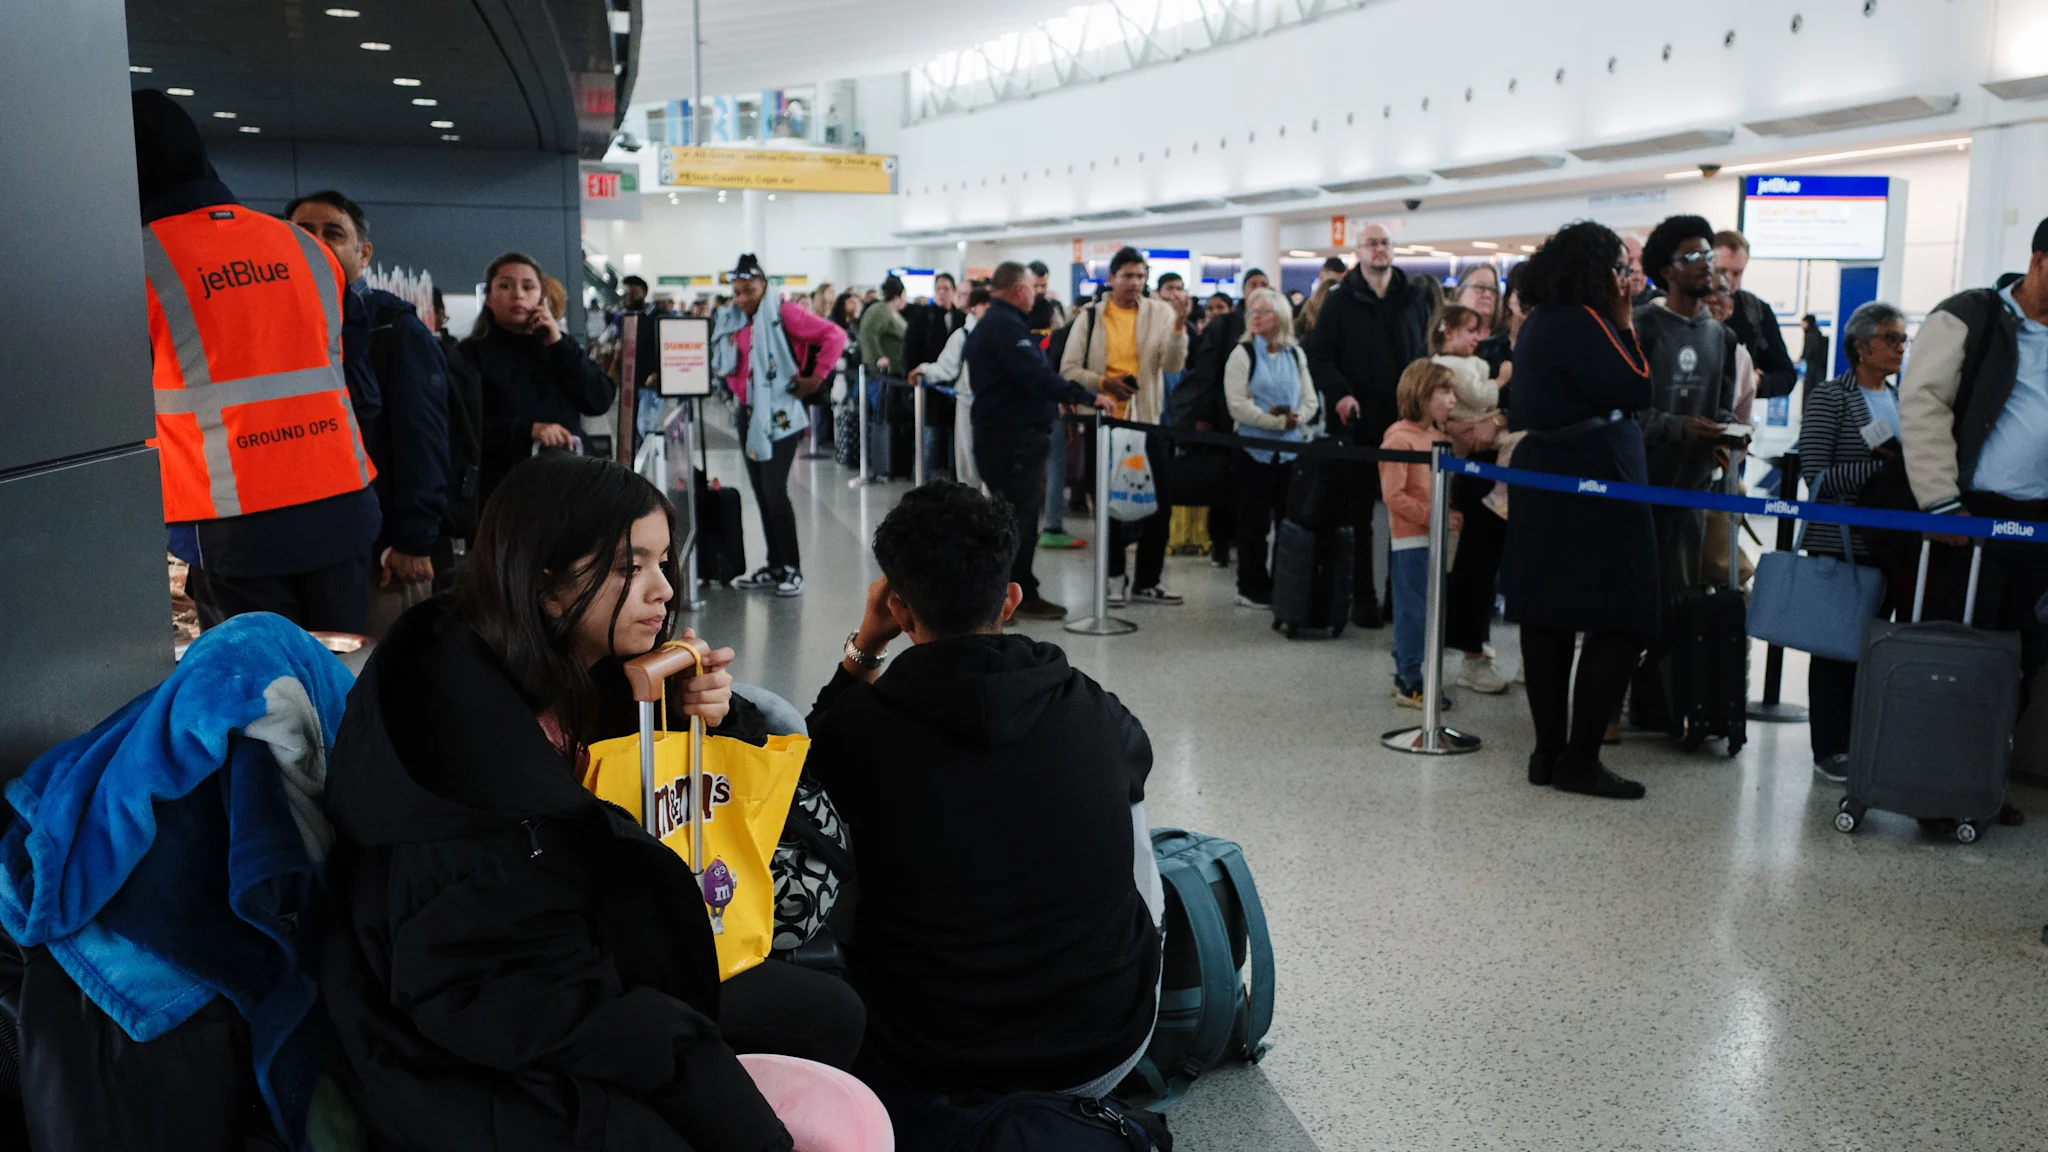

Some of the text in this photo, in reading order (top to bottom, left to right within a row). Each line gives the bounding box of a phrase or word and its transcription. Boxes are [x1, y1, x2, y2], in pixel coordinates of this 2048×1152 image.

[588, 174, 617, 198] EXIT
[1757, 177, 1801, 195] jetBlue
[197, 260, 289, 299] jetBlue
[236, 417, 339, 449] GROUND OPS
[1577, 478, 1608, 493] jetBlue
[1763, 500, 1800, 515] jetBlue
[1991, 519, 2035, 536] jetBlue
[714, 884, 731, 901] m
